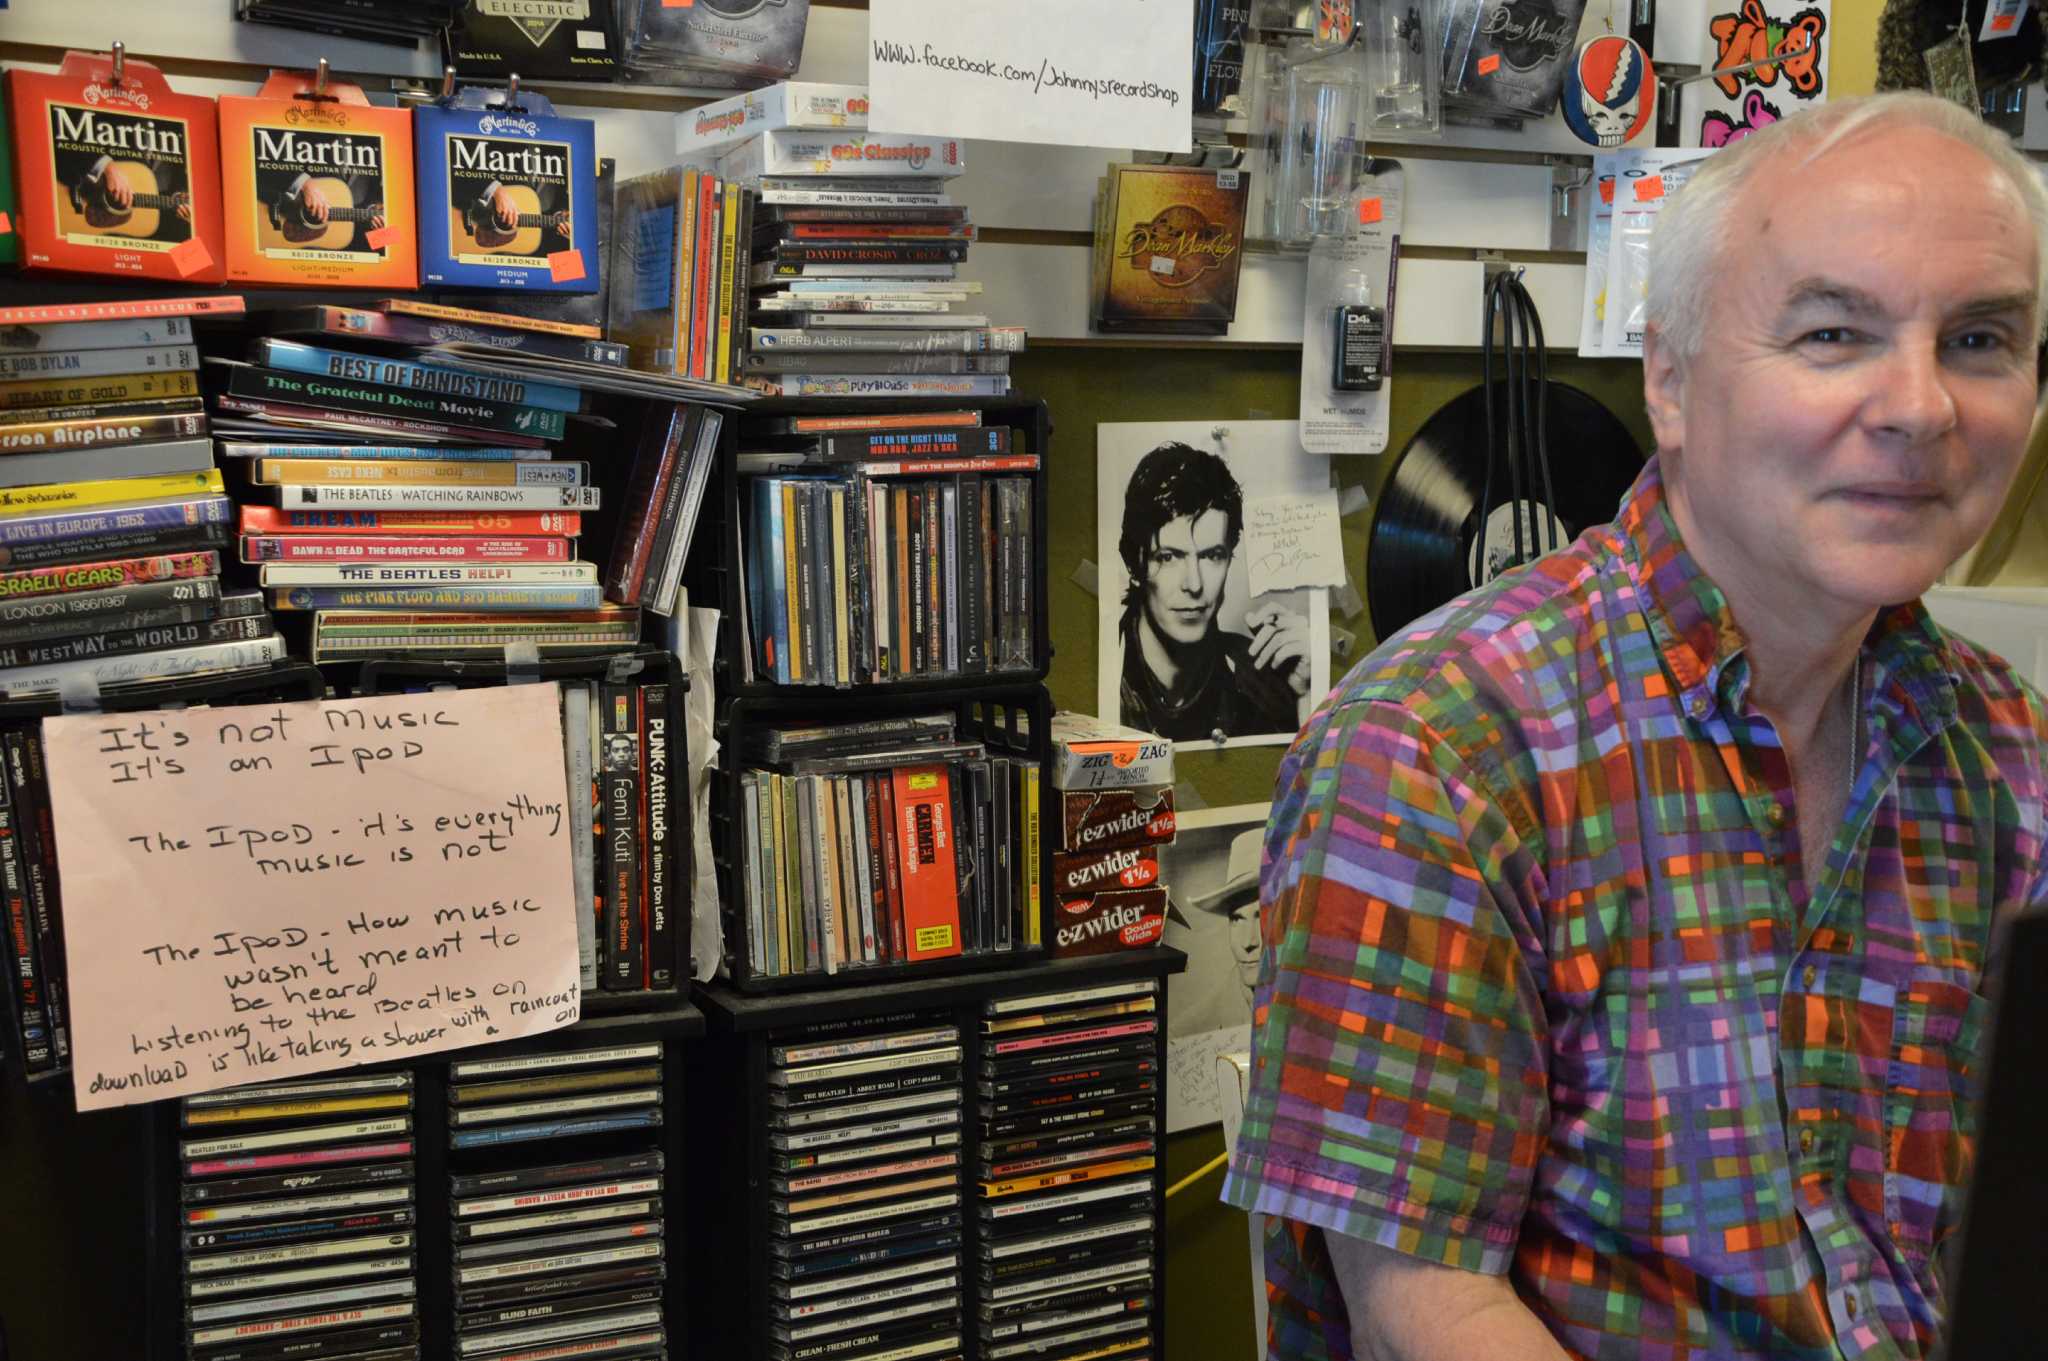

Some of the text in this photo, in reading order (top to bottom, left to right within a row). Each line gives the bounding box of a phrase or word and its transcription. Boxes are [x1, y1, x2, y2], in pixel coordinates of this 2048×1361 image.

[491, 2, 577, 16] ELECTRIC
[1208, 64, 1244, 79] FLOY
[54, 107, 183, 155] Martin
[58, 142, 184, 165] ACOUSTIC GUITAR STRINGS
[257, 130, 378, 167] Martin
[452, 139, 563, 176] Martin
[259, 162, 379, 177] ACOUSTIC GUITAR STRINGS
[454, 170, 566, 185] ACOUSTIC GUITAR STRINGS
[122, 240, 160, 250] BRONZE
[114, 254, 142, 263] LIGHT
[318, 252, 354, 261] BRONZE
[506, 257, 541, 266] BRONZE
[497, 270, 528, 279] MEDIUM
[12, 354, 80, 371] BOB DYLAN
[329, 356, 527, 404] BEST OF BANDSTAND
[8, 386, 128, 403] HEART OF GOLD
[265, 376, 495, 419] The Grateful Dead Movie
[324, 412, 350, 423] PAUL
[0, 425, 144, 448] rson Airplane
[324, 488, 524, 502] THE BEATLES WATCHING RAINBOWS
[6, 527, 36, 542] LIVE
[39, 524, 54, 538] IN
[58, 518, 107, 534] EUROPE
[292, 546, 324, 556] DAWN
[336, 546, 364, 556] DEAD
[367, 546, 387, 556] THE
[65, 567, 125, 588] GEARS
[339, 568, 513, 581] THE BEATLES HELP!
[4, 595, 128, 620] LONDON 1966/1967
[29, 635, 107, 663] WESTWAY
[136, 625, 200, 646] WORLD
[100, 721, 190, 753] It's
[219, 709, 292, 745] not
[1082, 745, 1168, 769] ZIG ZAG
[110, 756, 185, 783] It's
[229, 755, 273, 773] an
[128, 832, 192, 852] The
[434, 793, 562, 837] everything
[614, 777, 633, 863] Femi Kuti
[256, 829, 507, 876] music is not
[653, 853, 664, 872] film
[651, 873, 663, 883] by
[654, 885, 665, 905] Don
[655, 905, 665, 931] Letts
[1124, 918, 1162, 933] Double
[143, 943, 201, 966] The
[347, 912, 409, 935] How
[433, 898, 542, 925] music
[1125, 929, 1153, 944] Wide
[224, 925, 521, 990] wasn't meant to
[231, 972, 378, 1013] be heard
[260, 1013, 293, 1033] to
[306, 1006, 356, 1027] the
[374, 984, 477, 1015] Beatles
[492, 979, 527, 996] on
[554, 1005, 578, 1024] on
[207, 1052, 230, 1073] is
[242, 1041, 281, 1068] like
[280, 1029, 352, 1059] taking
[360, 1034, 376, 1049] a
[451, 1004, 490, 1028] with
[510, 982, 578, 1016] raincoat
[500, 1305, 553, 1322] BLIND FAITH
[795, 1334, 880, 1359] CREAM FRESH CREAM
